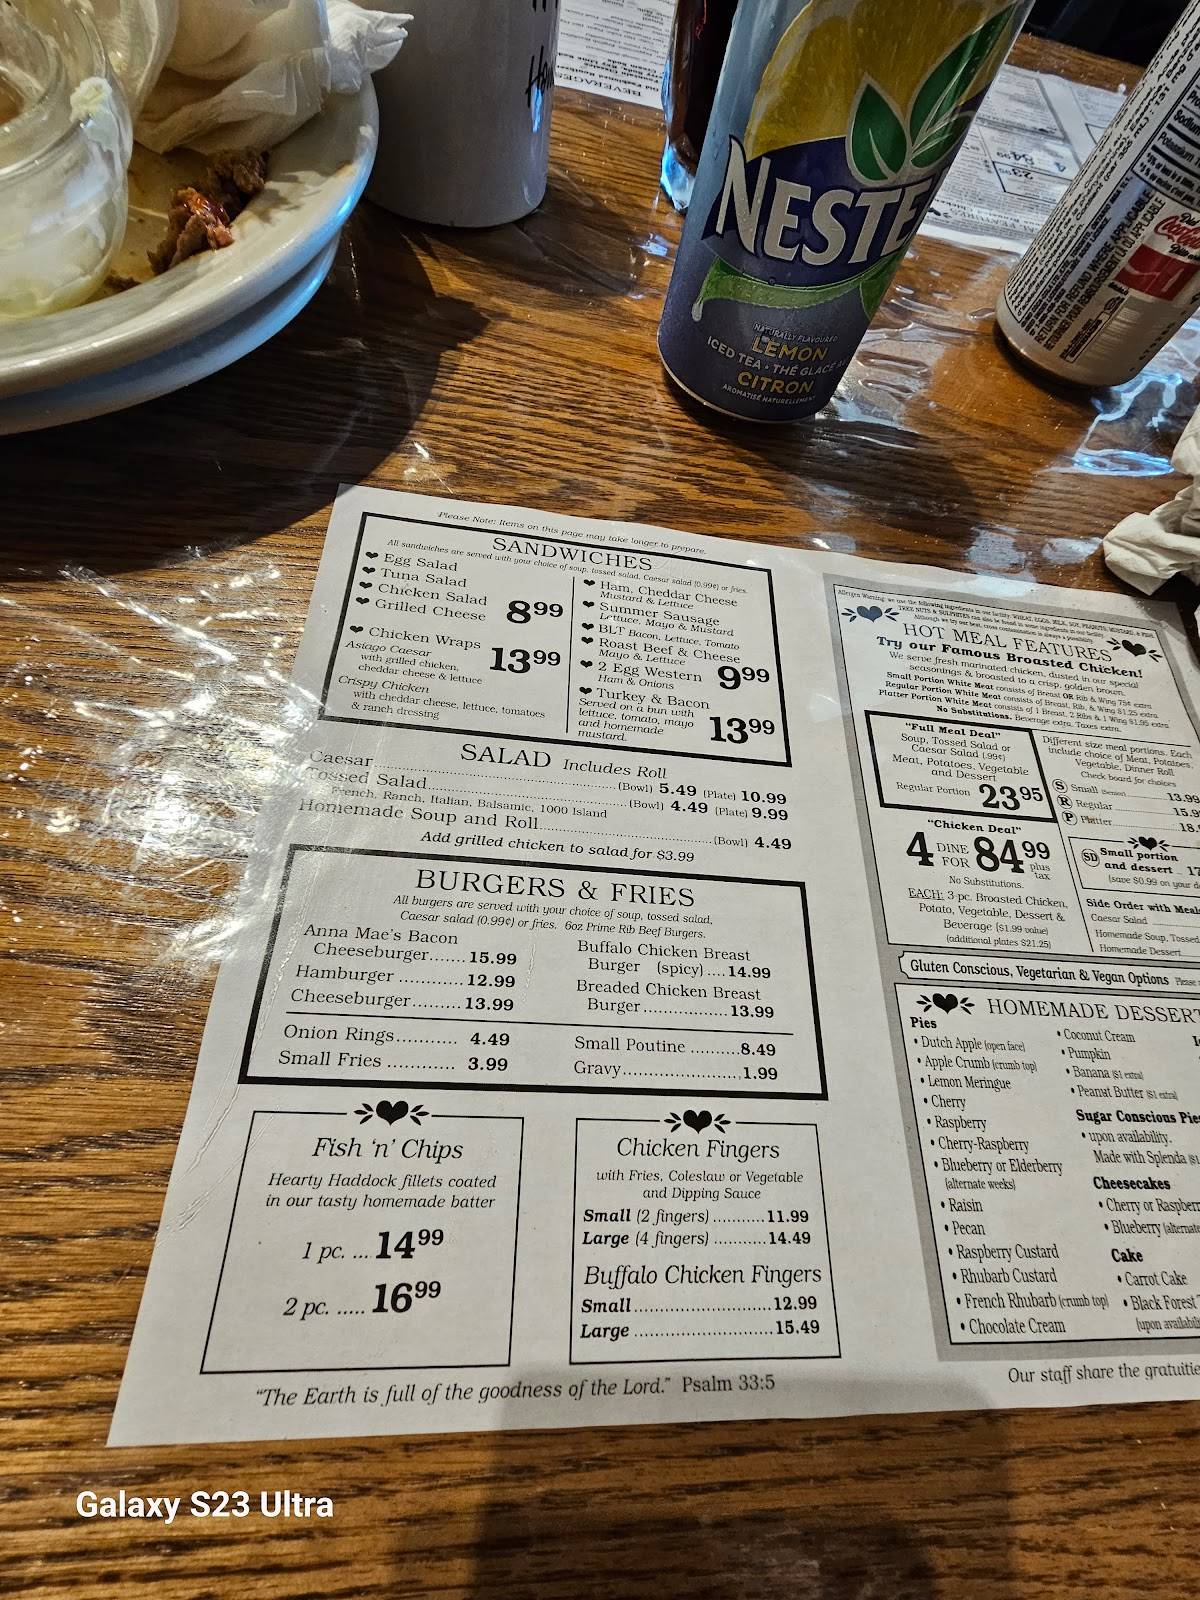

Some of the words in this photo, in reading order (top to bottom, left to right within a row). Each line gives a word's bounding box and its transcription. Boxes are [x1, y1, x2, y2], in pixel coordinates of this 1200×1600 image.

[1129, 196, 1167, 242] APPLICABLE
[1033, 313, 1061, 346] RETURN
[1053, 298, 1072, 319] FOR
[1064, 269, 1094, 304] REFUND
[1086, 239, 1117, 275] WHERE
[1108, 187, 1155, 246] APPLICABLE
[706, 335, 737, 360] ICED
[738, 351, 762, 371] TEA
[772, 363, 800, 377] THÉ
[751, 335, 828, 362] LEMON
[736, 370, 815, 395] CITRON
[383, 553, 412, 568] Egg
[416, 557, 458, 572] Salad
[492, 536, 654, 572] SANDWICHES
[380, 567, 420, 582] Tuna
[425, 573, 467, 588] Salad
[378, 583, 440, 600] Chicken
[445, 591, 487, 606] Salad
[600, 580, 634, 594] Ham,
[638, 586, 692, 604] Cheddar
[694, 592, 738, 607] Cheese
[375, 598, 427, 615] Grilled
[432, 606, 486, 621] Cheese
[599, 601, 659, 622] Summer
[662, 610, 720, 630] Sausage
[368, 626, 429, 643] Chicken
[435, 634, 481, 651] Wraps
[902, 622, 946, 640] HOT
[951, 627, 1011, 648] MEAL
[1012, 636, 1114, 664] FEATURES
[599, 637, 637, 651] Roast
[643, 642, 674, 656] Beef
[677, 647, 688, 657] &
[693, 649, 741, 664] Cheese
[876, 635, 903, 650] Try
[909, 642, 937, 652] our
[941, 641, 1003, 663] Famous
[1006, 651, 1074, 675] Broasted
[1078, 659, 1143, 679] Chicken!
[338, 675, 379, 690] Crispy
[381, 680, 430, 694] Chicken
[938, 726, 966, 736] Meal
[460, 743, 552, 768] SALAD
[562, 758, 631, 776] Includes
[636, 765, 666, 779] Roll
[420, 831, 451, 844] Add
[454, 834, 504, 848] grilled
[508, 838, 565, 853] chicken
[568, 845, 584, 858] to
[588, 845, 629, 858] salad
[629, 847, 653, 861] for
[656, 849, 695, 863] $3.99
[905, 831, 935, 867] 4
[936, 842, 970, 855] DINE
[1099, 847, 1134, 858] Small
[1136, 852, 1179, 862] portion
[941, 856, 971, 869] FOR
[1029, 862, 1051, 873] plus
[1104, 861, 1128, 871] and
[1130, 862, 1174, 874] dessert
[415, 869, 565, 898] BURGERS
[577, 880, 599, 901] &
[610, 882, 695, 907] FRIES
[303, 924, 348, 938] Anna
[407, 929, 458, 945] Bacon
[577, 939, 632, 955] Buffalo
[637, 943, 698, 959] Chicken
[703, 947, 751, 962] Breast
[910, 958, 950, 973] Gluten
[952, 961, 1013, 978] Conscious,
[1015, 965, 1077, 982] Vegetarian
[1079, 968, 1091, 982] &
[1091, 969, 1126, 986] Vegan
[1127, 971, 1170, 988] Options
[987, 998, 1109, 1020] HOMEMADE
[909, 1016, 938, 1029] Pies
[920, 1035, 954, 1049] Dutch
[955, 1036, 983, 1053] Apple
[1066, 1046, 1112, 1063] Pumpkin
[931, 1094, 966, 1109] Cherry
[934, 1115, 987, 1133] Raspberry
[1075, 1108, 1113, 1126] Sugar
[1115, 1109, 1177, 1124] Conscious
[311, 1137, 362, 1158] Fish
[401, 1138, 464, 1165] Chips
[617, 1137, 700, 1157] Chicken
[706, 1139, 780, 1164] Fingers
[1092, 1176, 1171, 1190] Cheesecakes
[948, 1197, 984, 1213] Raisin
[951, 1220, 986, 1236] Pecan
[583, 1264, 658, 1290] Buffalo
[665, 1264, 745, 1284] Chicken
[751, 1264, 822, 1289] Fingers
[1124, 1271, 1161, 1287] Carrot
[1160, 1270, 1188, 1286] Cake
[968, 1317, 1026, 1335] Chocolate
[1028, 1317, 1067, 1334] Cream
[1008, 1367, 1036, 1383] Our
[1040, 1364, 1073, 1385] staff
[1076, 1364, 1114, 1380] share
[1118, 1362, 1140, 1378] the
[303, 1385, 356, 1405] Earth
[363, 1386, 379, 1403] is
[380, 1383, 416, 1407] full
[421, 1383, 443, 1406] of
[445, 1383, 474, 1401] the
[478, 1380, 563, 1404] goodness
[568, 1379, 589, 1401] of
[591, 1378, 618, 1396] the
[682, 1375, 733, 1393] Psalm
[738, 1373, 776, 1391] 33:5
